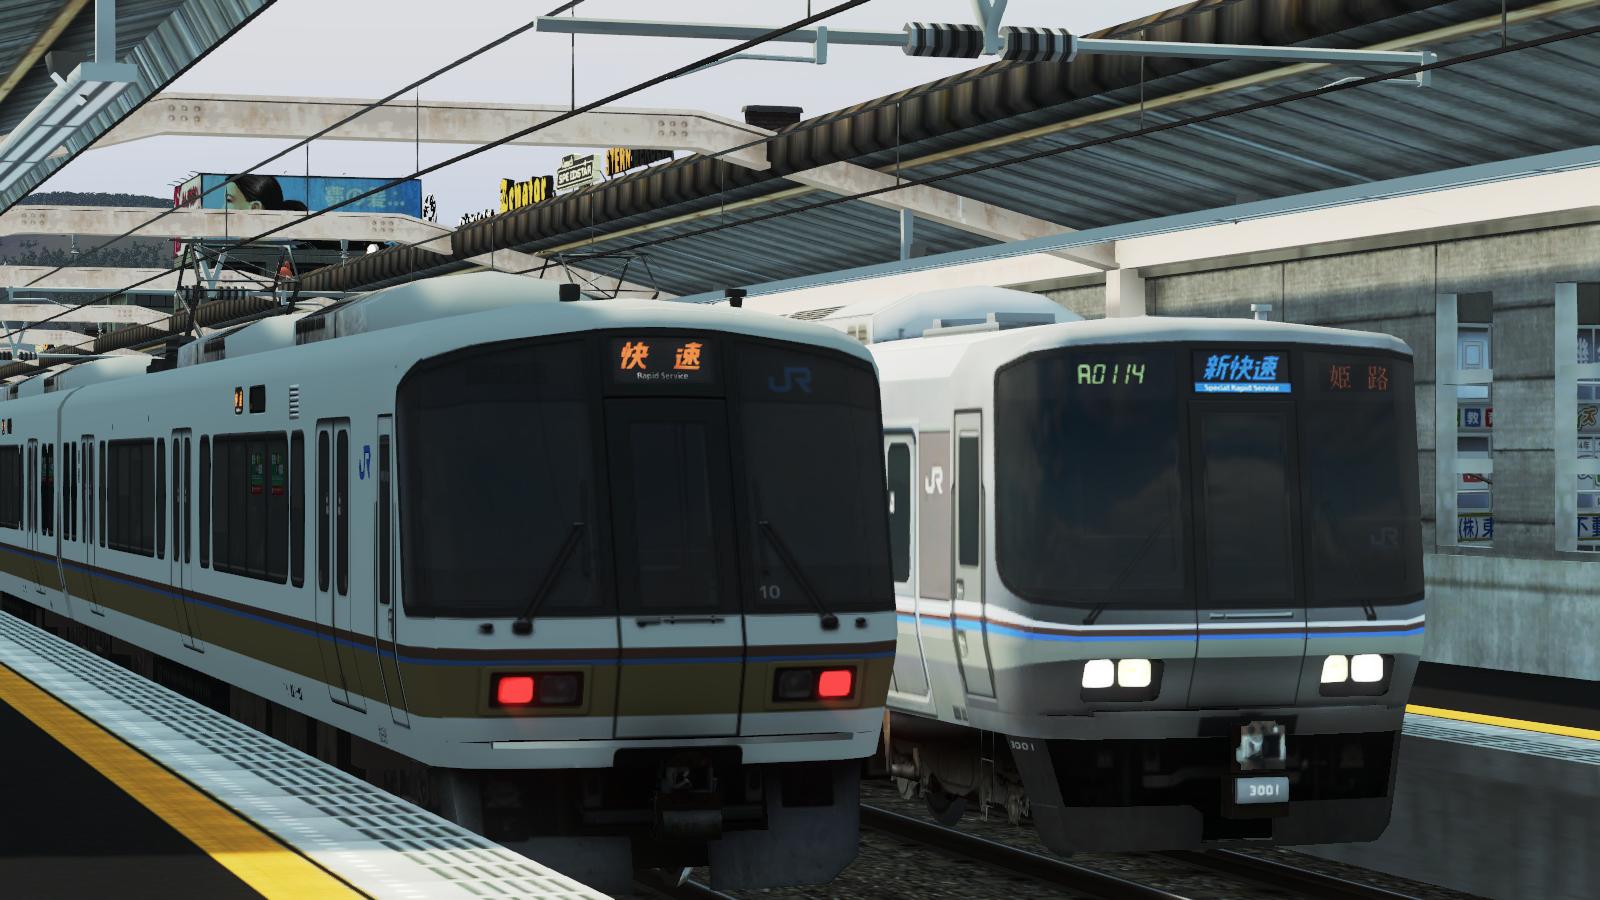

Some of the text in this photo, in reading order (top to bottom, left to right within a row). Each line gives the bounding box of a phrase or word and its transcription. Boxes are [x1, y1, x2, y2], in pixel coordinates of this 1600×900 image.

[636, 371, 689, 381] Rapid Service
[1077, 362, 1146, 385] A0114
[1203, 353, 1280, 381] 新快速
[767, 366, 814, 394] JR
[1203, 383, 1280, 393] Special Rapid Service
[358, 445, 371, 481] JR
[924, 466, 944, 495] JR
[759, 584, 781, 600] 10
[1249, 783, 1281, 797] 3001
